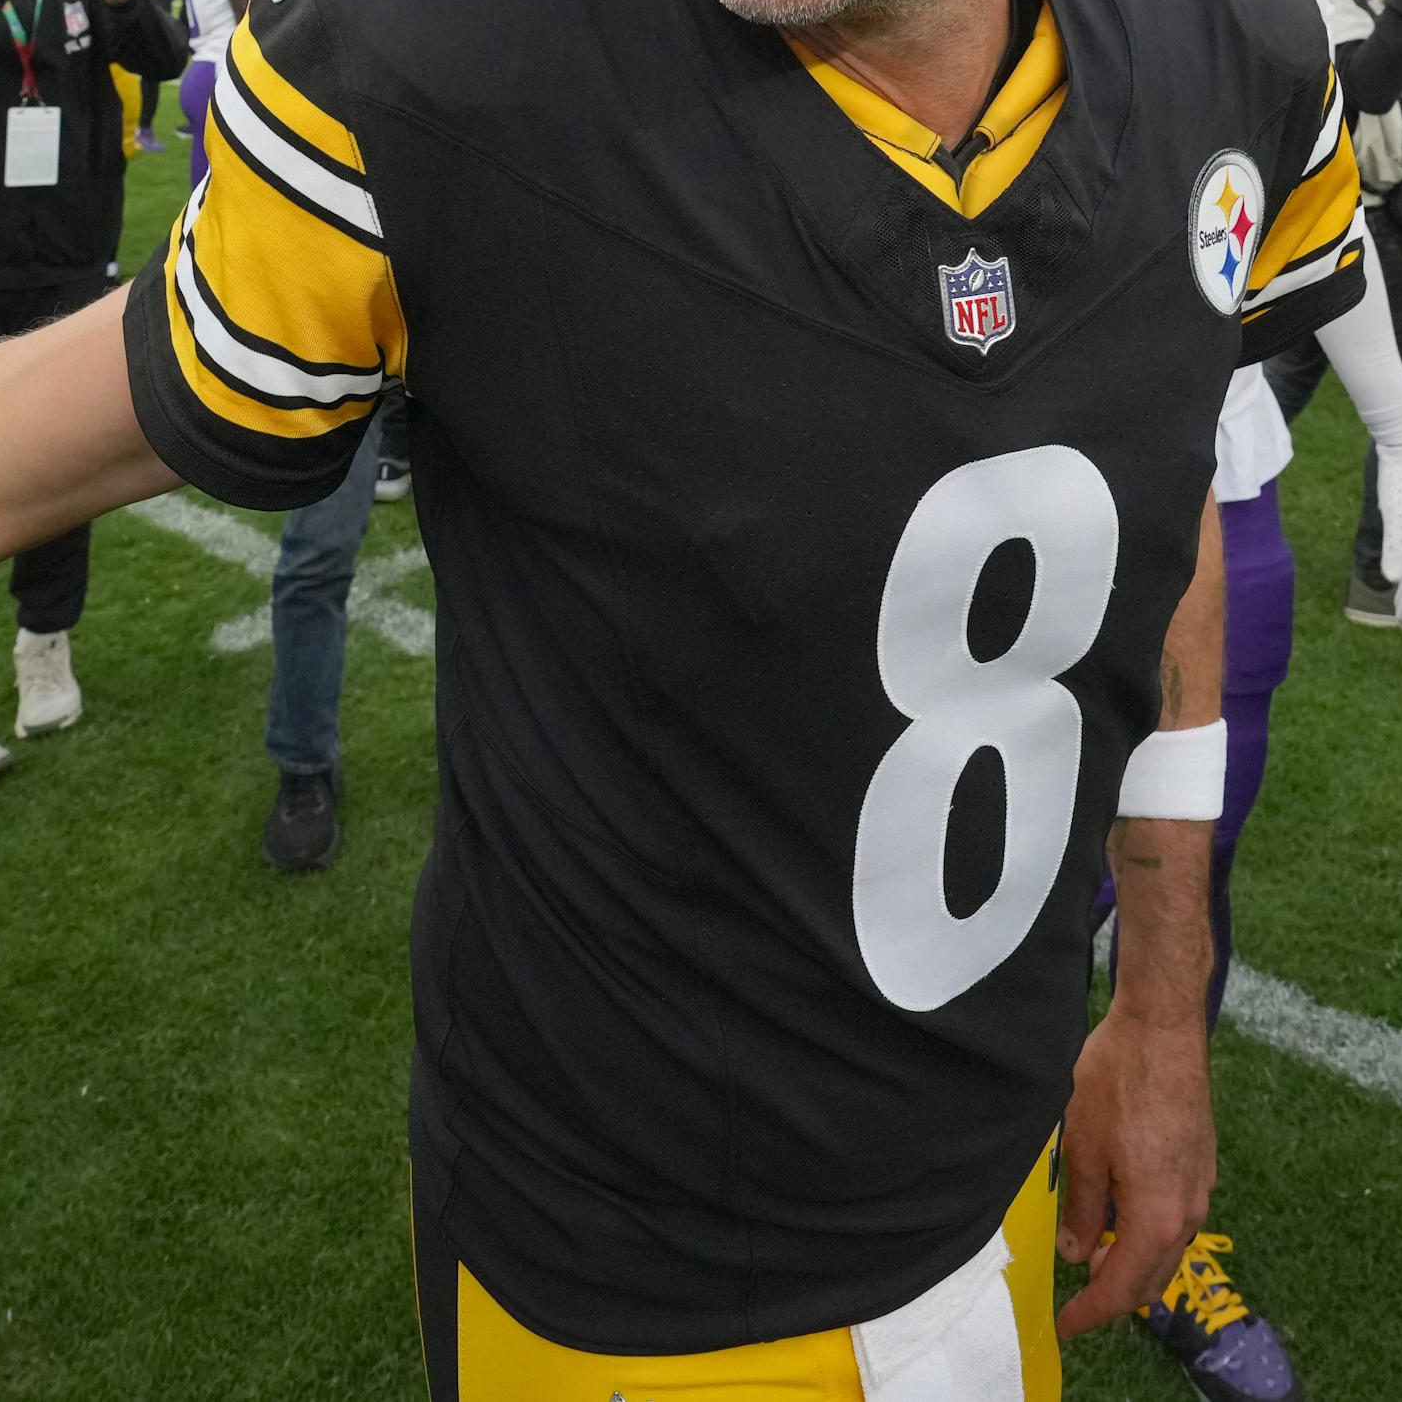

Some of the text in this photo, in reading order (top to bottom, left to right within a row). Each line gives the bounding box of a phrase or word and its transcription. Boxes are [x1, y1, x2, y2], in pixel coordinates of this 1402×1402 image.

[1199, 226, 1228, 250] Steelers
[954, 295, 1007, 336] NFL
[851, 443, 1121, 1013] 8
